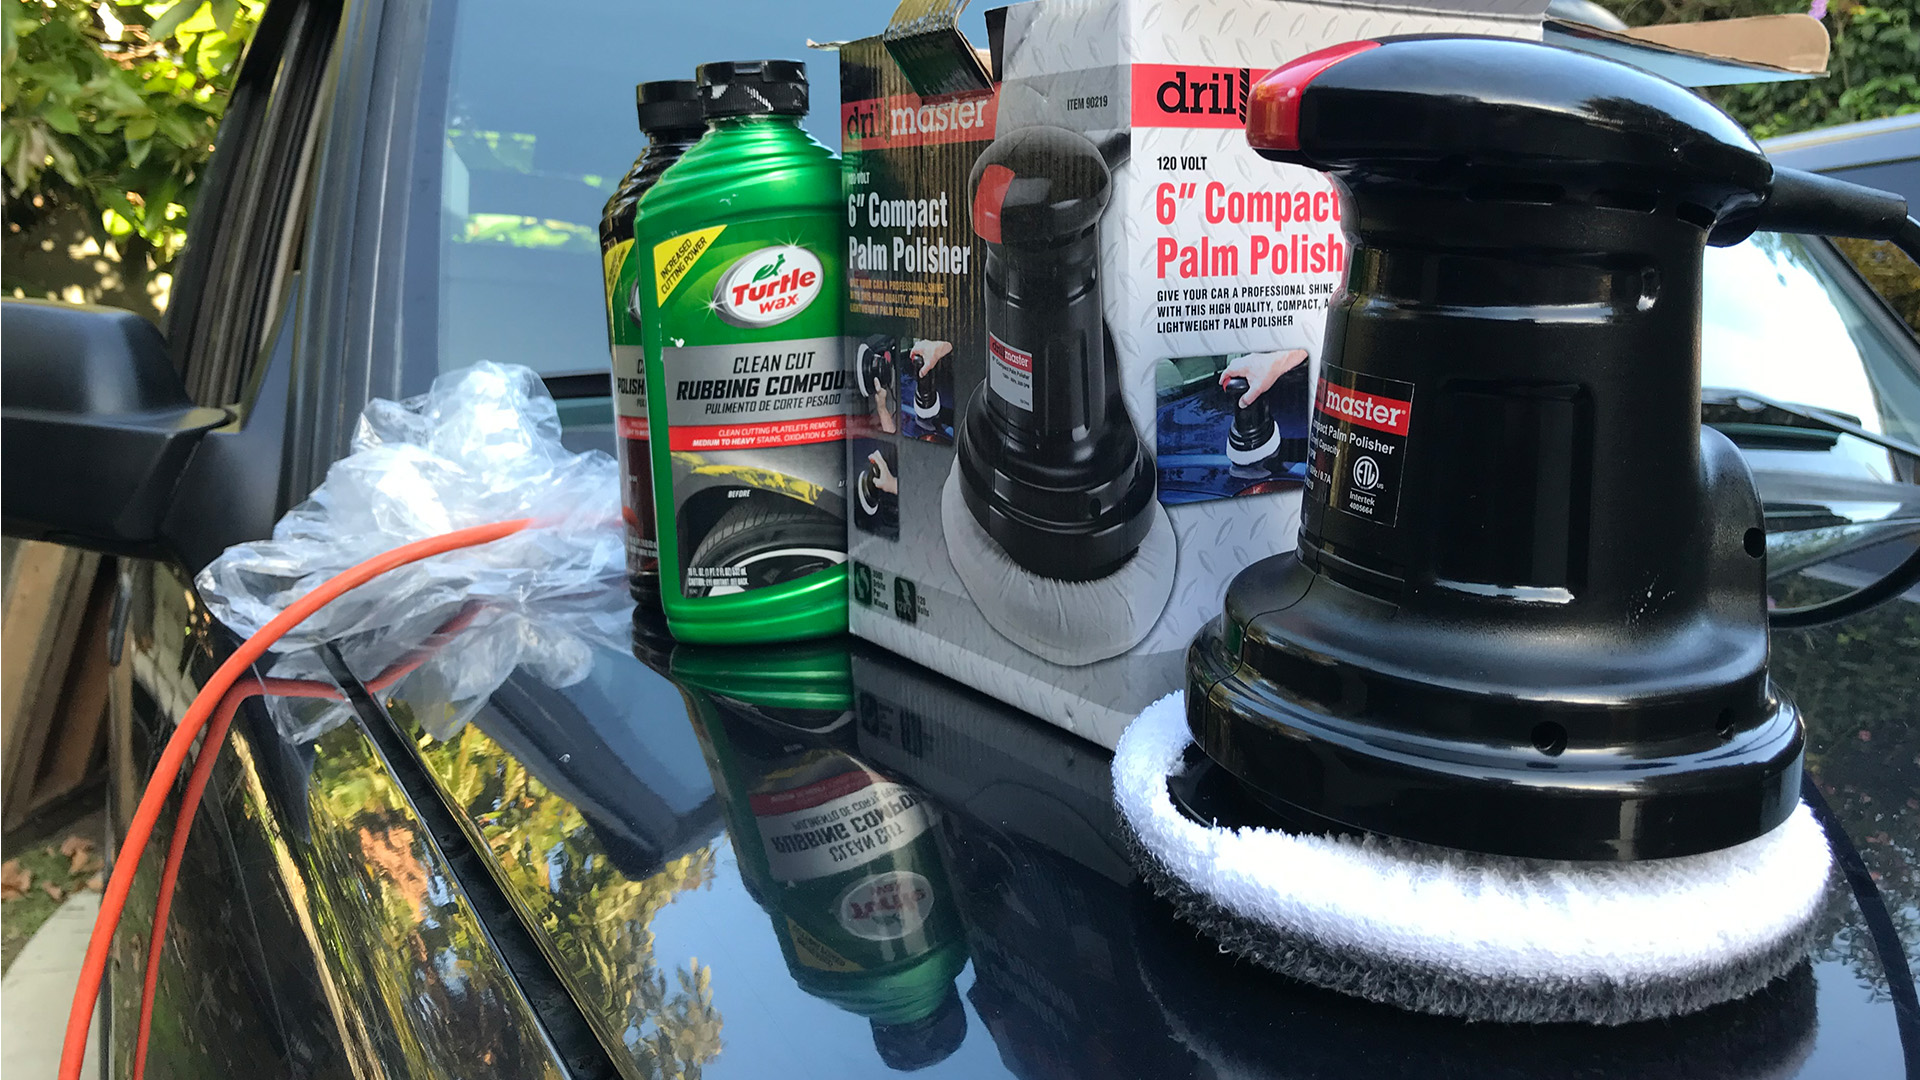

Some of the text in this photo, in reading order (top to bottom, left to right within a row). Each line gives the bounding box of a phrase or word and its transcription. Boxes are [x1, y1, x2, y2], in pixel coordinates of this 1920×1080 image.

[1067, 95, 1108, 111] ITEM 90219
[891, 99, 987, 136] master
[1157, 156, 1207, 171] 120 VOLT
[869, 192, 948, 235] Compact
[1205, 181, 1341, 232] Compact
[660, 238, 692, 279] INCREASED
[661, 236, 708, 294] CUTTING POWER
[849, 236, 970, 274] Palm Polisher
[1157, 236, 1238, 279] Palm
[732, 268, 817, 307] Turtle
[1157, 283, 1334, 301] GIVE YOUR CAR A PROFESSIONAL SHINE
[759, 293, 798, 315] wax
[1157, 305, 1182, 318] WITH
[1185, 304, 1206, 316] THIS
[1209, 303, 1231, 315] HIGH
[1234, 301, 1274, 314] QUALITY,
[1277, 299, 1321, 312] COMPACT,
[1157, 315, 1294, 334] LIGHTWEIGHT PALM POLISHER
[733, 351, 816, 374] CLEAN CUT
[676, 377, 761, 401] RUBBING
[705, 393, 841, 415] PULIMENTO DE CORTE PESADO
[1326, 390, 1401, 427] master
[692, 438, 720, 447] MEDIUM
[721, 438, 730, 446] TO
[731, 437, 755, 446] HEAVY
[784, 432, 820, 441] OXIDATION
[718, 420, 837, 437] CLEAN CUTTING PLATELETS REMOVE
[1319, 439, 1341, 457] Capacity
[1328, 425, 1348, 442] Palm
[1349, 432, 1395, 455] Polisher
[727, 489, 751, 498] BEFORE
[1350, 491, 1375, 506] Intertek
